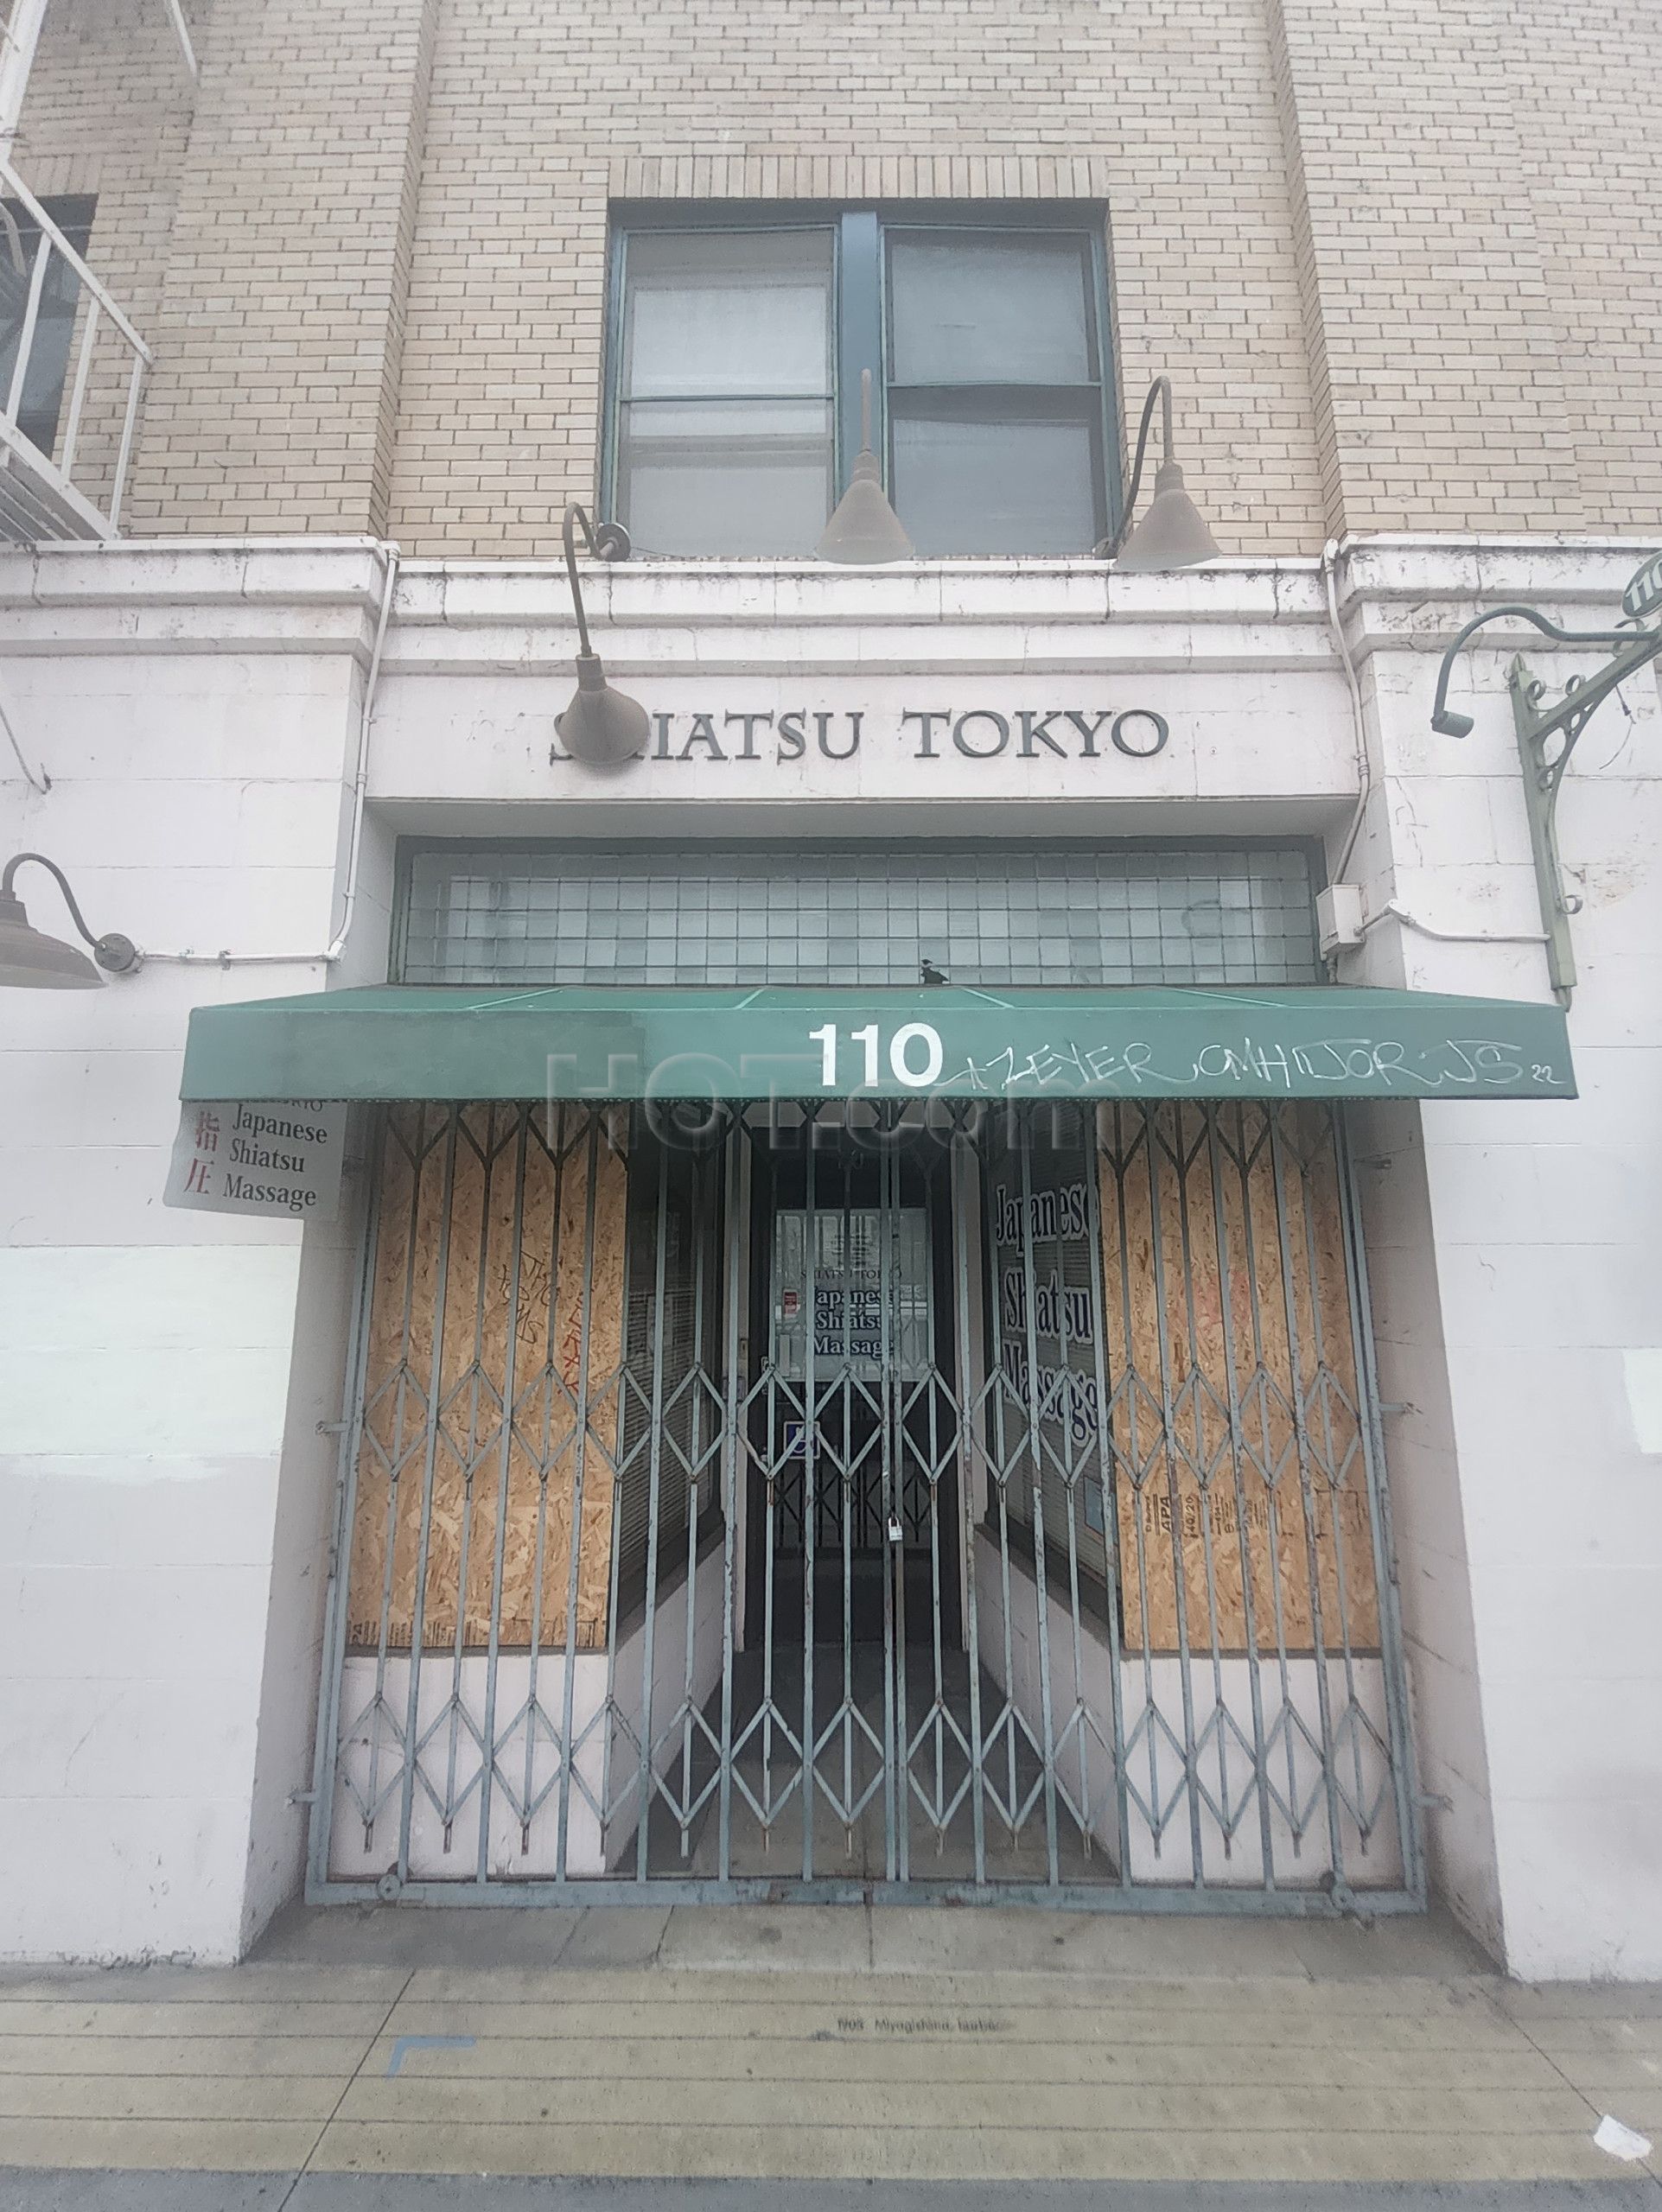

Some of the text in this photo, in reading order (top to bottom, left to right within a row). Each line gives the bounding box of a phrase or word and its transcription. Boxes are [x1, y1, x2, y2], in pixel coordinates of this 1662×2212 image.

[549, 708, 1169, 766] IATSU TOKYO
[809, 1021, 944, 1088] 110
[232, 1103, 328, 1145] Japanese
[183, 1110, 221, 1195] 指圧
[229, 1137, 305, 1173] Shiatsu
[222, 1173, 317, 1212] Massage
[1004, 1270, 1092, 1339] Shatsu
[812, 1336, 895, 1359] Masage
